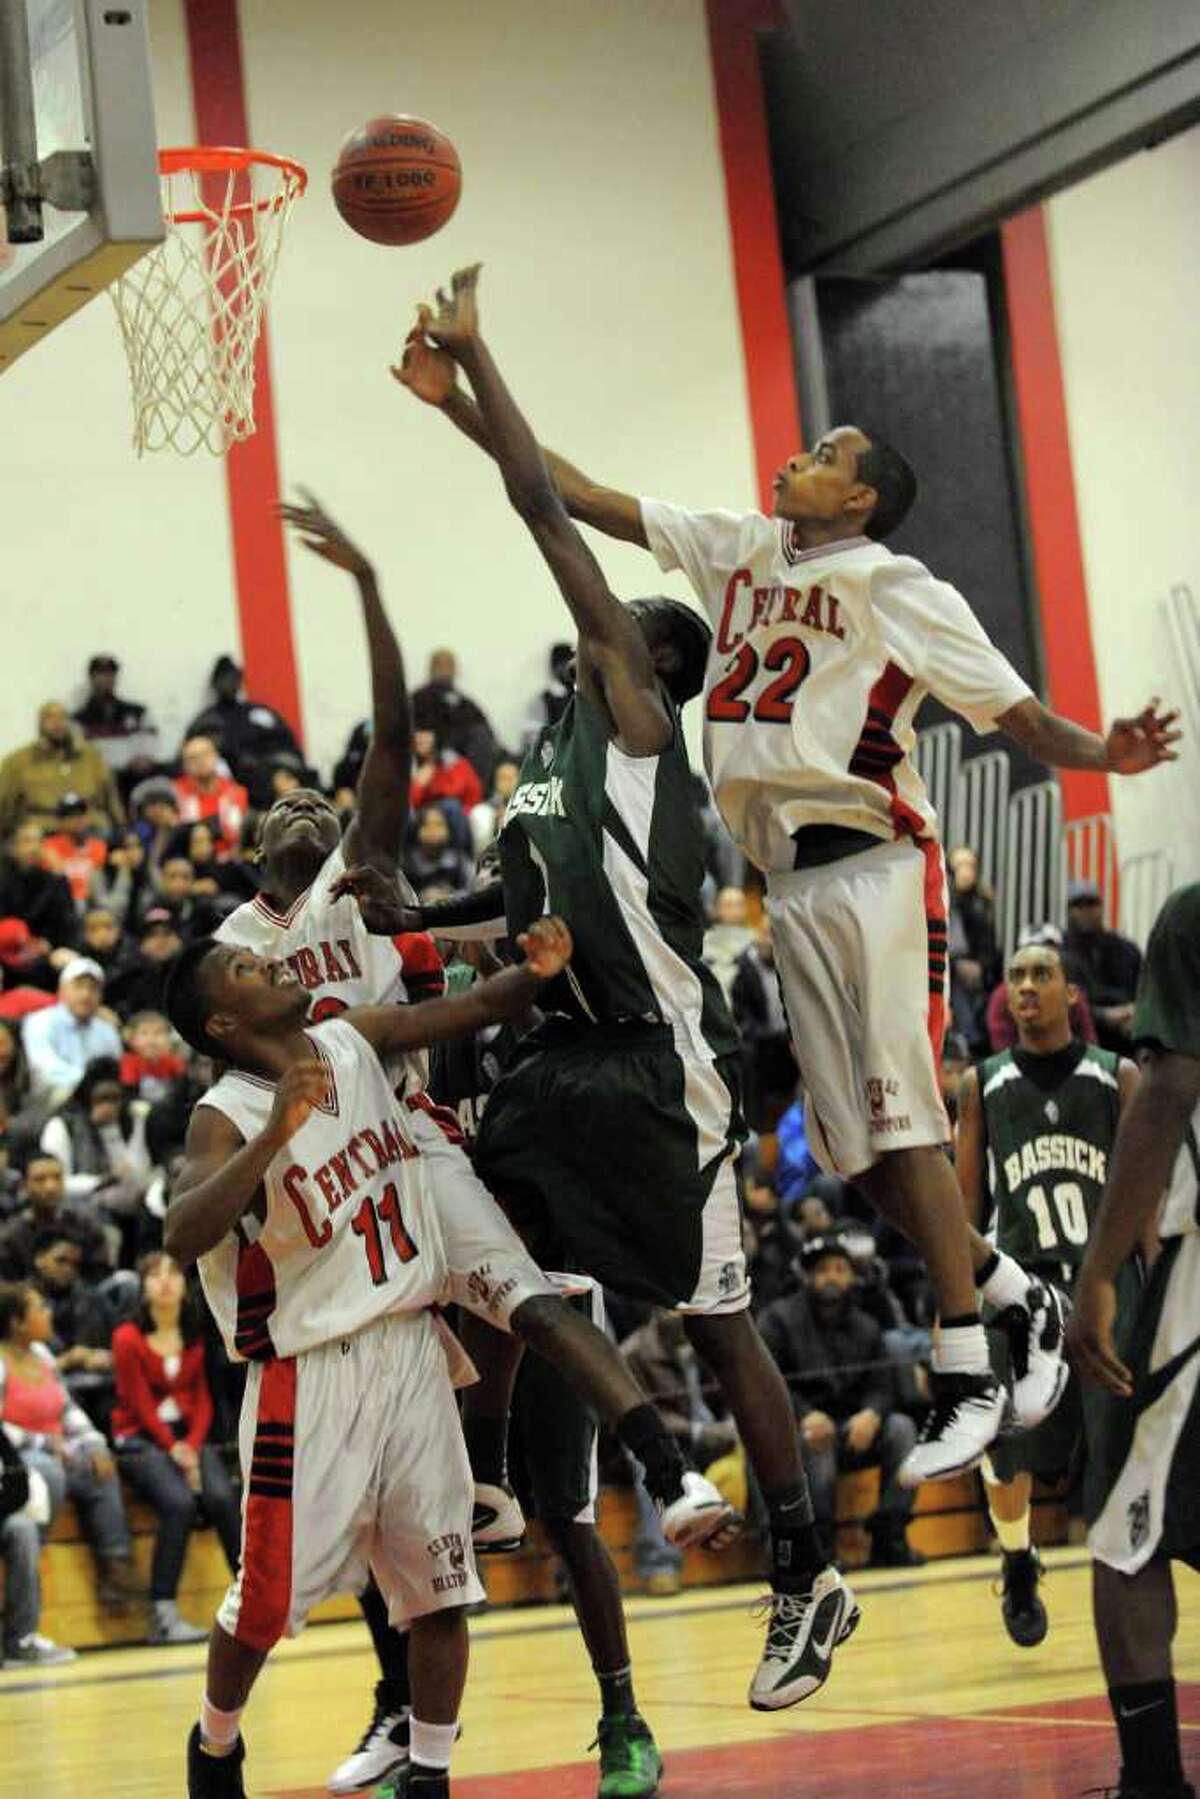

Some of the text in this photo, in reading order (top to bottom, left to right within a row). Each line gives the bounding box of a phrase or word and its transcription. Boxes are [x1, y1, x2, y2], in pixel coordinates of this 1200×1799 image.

[705, 636, 811, 724] 22
[283, 1117, 420, 1249] CENTRAL
[1003, 1133, 1107, 1194] BASSICK
[351, 1181, 420, 1288] 11
[1026, 1181, 1089, 1250] 10
